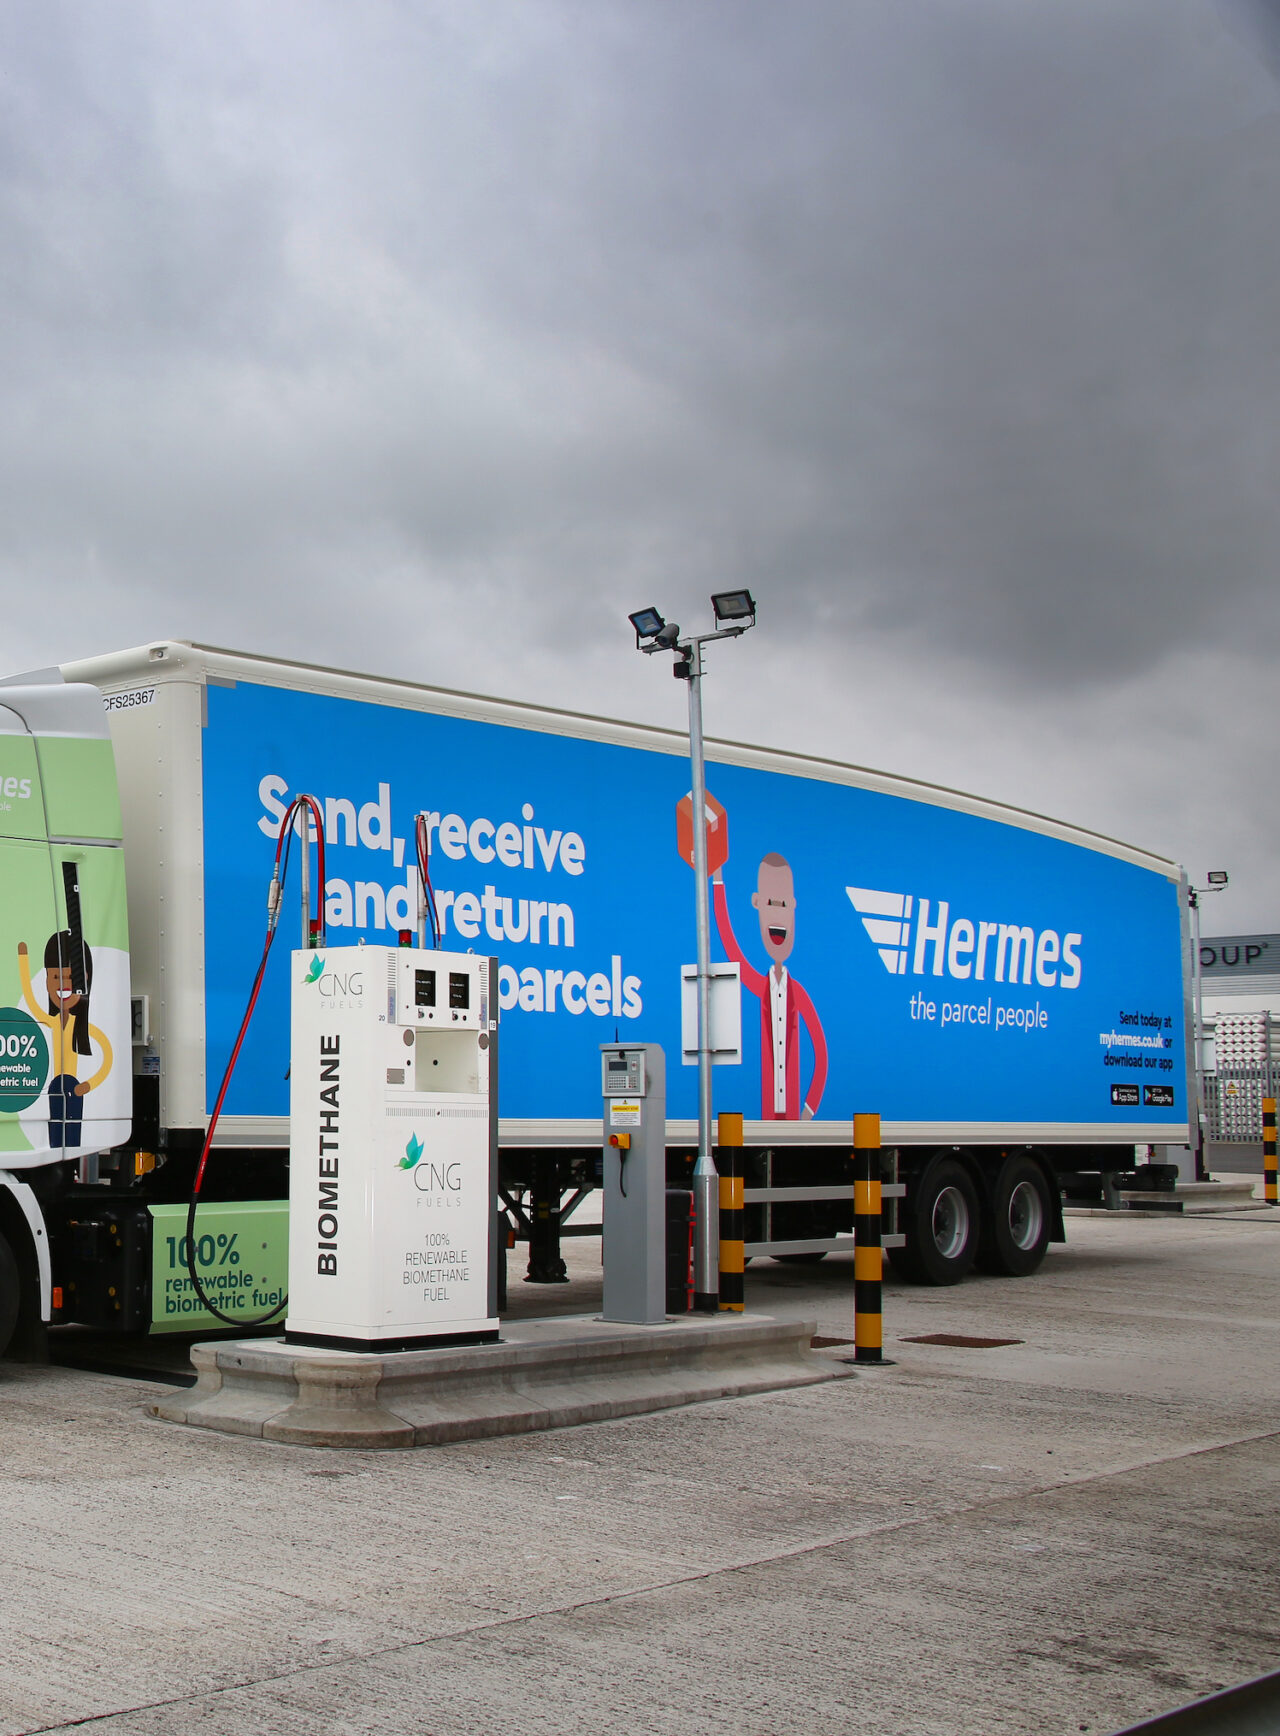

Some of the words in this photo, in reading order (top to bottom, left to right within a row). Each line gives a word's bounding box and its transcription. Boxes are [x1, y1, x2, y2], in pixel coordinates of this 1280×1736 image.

[257, 774, 406, 868] Send,
[420, 802, 586, 876] receive
[325, 865, 419, 933] and
[435, 885, 575, 947] return
[912, 898, 1083, 990] Hermes
[1199, 944, 1262, 966] OUP
[318, 972, 363, 997] CNG
[498, 954, 643, 1025] parcels
[320, 1000, 364, 1009] FUELS
[909, 991, 937, 1021] the
[941, 997, 992, 1028] parcel
[995, 1001, 1048, 1033] people
[1119, 1010, 1139, 1025] Send
[1140, 1012, 1163, 1030] today
[1164, 1015, 1173, 1028] at
[1099, 1029, 1164, 1049] myhermes.co.uk
[1164, 1038, 1173, 1049] or
[1103, 1050, 1143, 1068] download
[1144, 1057, 1157, 1069] our
[1158, 1058, 1173, 1072] app
[22, 1077, 39, 1087] fuel
[317, 1034, 340, 1276] BIOMETHANE
[413, 1162, 461, 1192] CNG
[416, 1197, 461, 1208] FUELS
[166, 1233, 240, 1269] 100%
[424, 1233, 450, 1247] 100%
[405, 1250, 468, 1266] RENEWABLE
[403, 1268, 470, 1285] BIOMETHANE
[165, 1291, 245, 1314] biometric
[252, 1288, 283, 1307] fuel
[423, 1287, 450, 1301] FUEL
